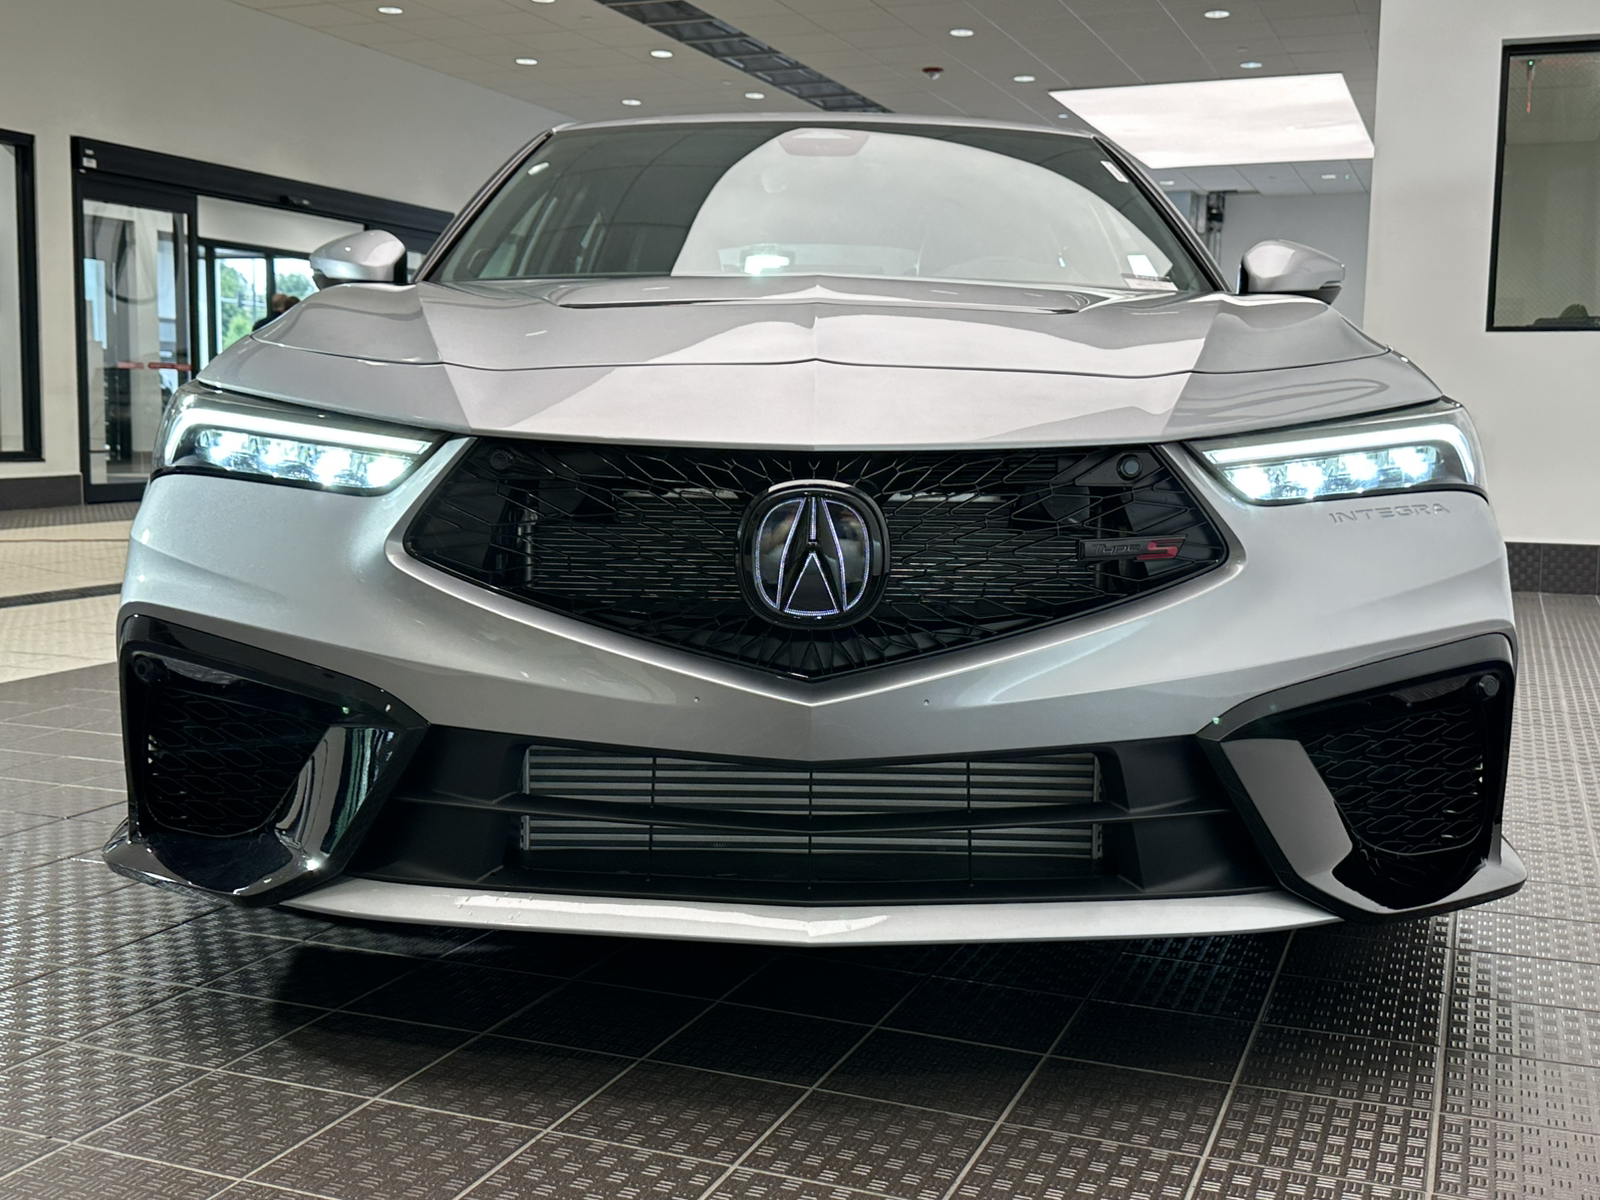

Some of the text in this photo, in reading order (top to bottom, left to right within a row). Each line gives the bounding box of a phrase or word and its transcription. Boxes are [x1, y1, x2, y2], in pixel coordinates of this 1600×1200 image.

[1328, 503, 1450, 523] INTEGRA
[1092, 539, 1185, 560] Type S
